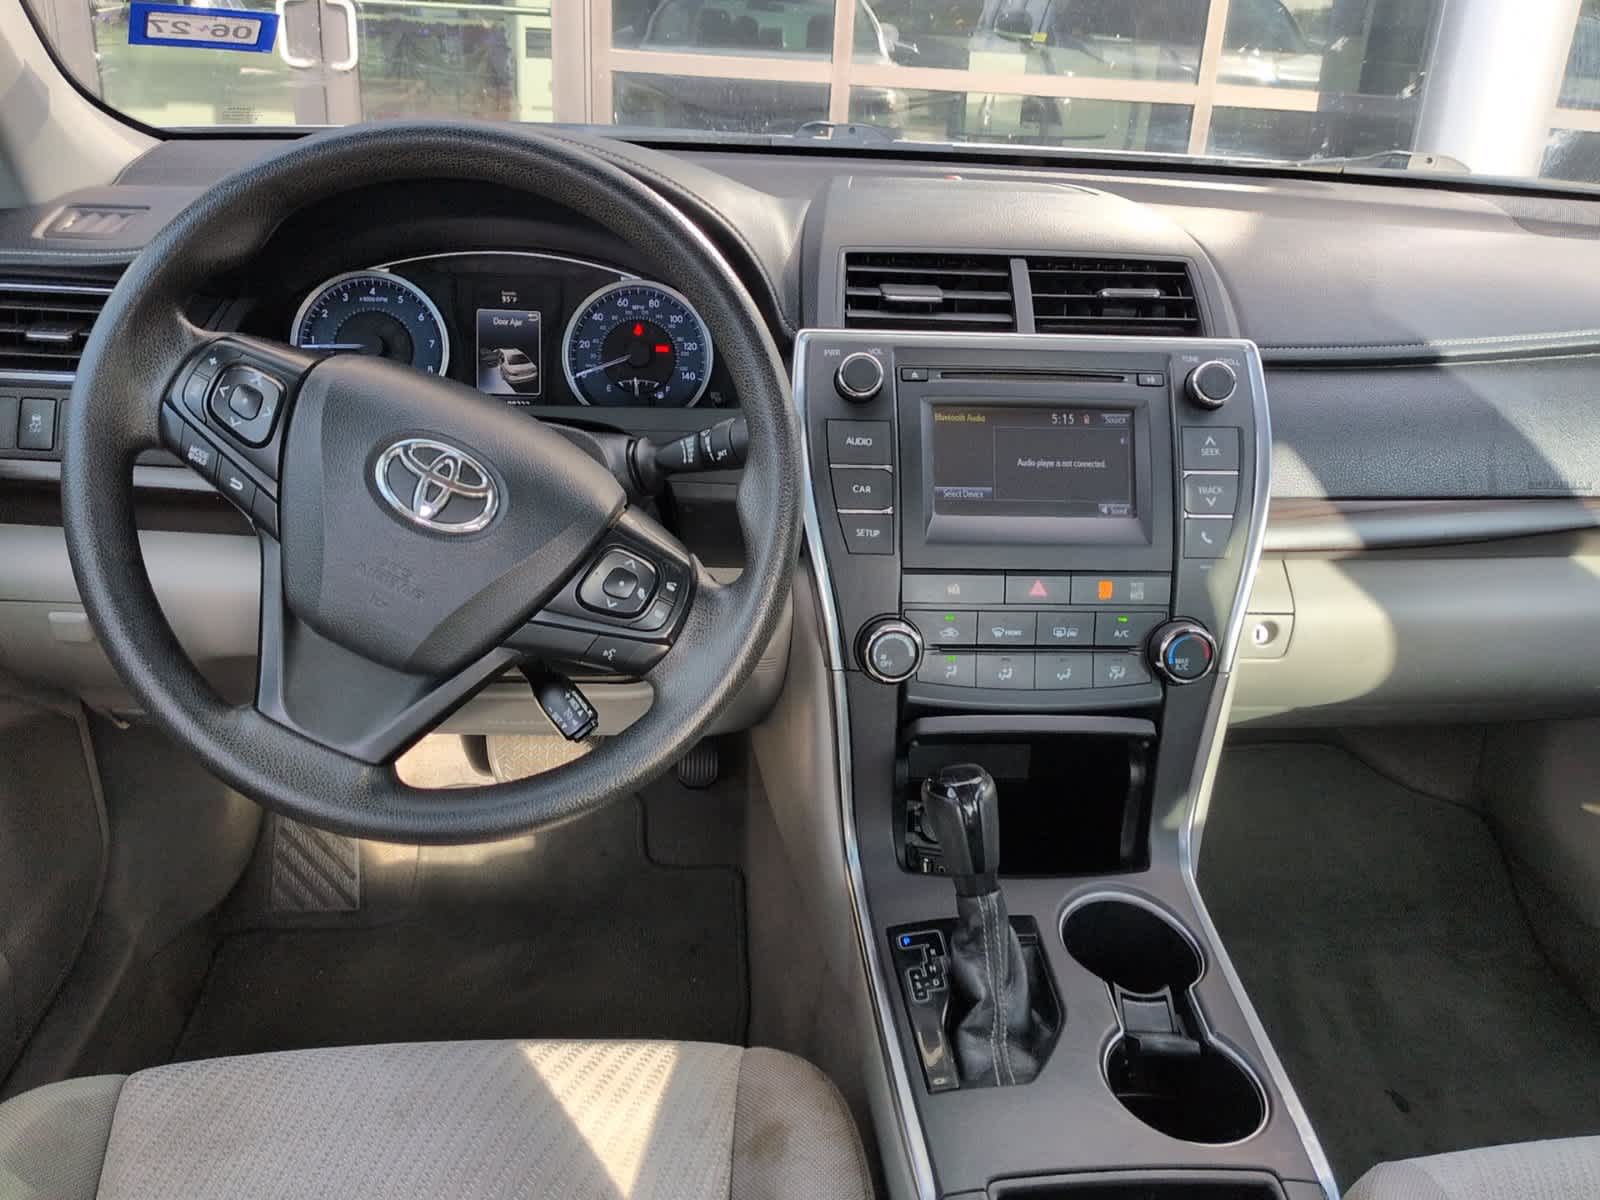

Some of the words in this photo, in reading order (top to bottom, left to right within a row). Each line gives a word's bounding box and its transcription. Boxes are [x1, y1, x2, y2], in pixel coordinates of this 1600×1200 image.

[369, 287, 376, 295] 4
[342, 293, 349, 302] 3
[397, 296, 404, 304] 5
[617, 298, 629, 307] 60
[649, 298, 660, 308] 80
[322, 309, 328, 318] 2
[418, 313, 425, 321] 6
[592, 312, 604, 321] 40
[493, 317, 508, 326] Door
[509, 318, 523, 327] Ajar
[670, 315, 683, 323] 100
[429, 340, 435, 348] 7
[579, 340, 591, 349] 20
[684, 342, 697, 351] 120
[681, 371, 696, 380] 140
[967, 414, 985, 423] Audio
[1051, 414, 1075, 425] 5:15
[846, 437, 873, 446] AUDIO
[1200, 448, 1220, 456] SEEK
[1017, 458, 1036, 468] Audio
[1037, 459, 1055, 469] player
[1061, 460, 1072, 468] not
[852, 484, 871, 493] CAR
[1198, 486, 1222, 495] TRACK
[943, 488, 963, 498] Select
[963, 489, 984, 499] Device
[856, 528, 880, 537] SETUP
[1114, 629, 1129, 638] A/C
